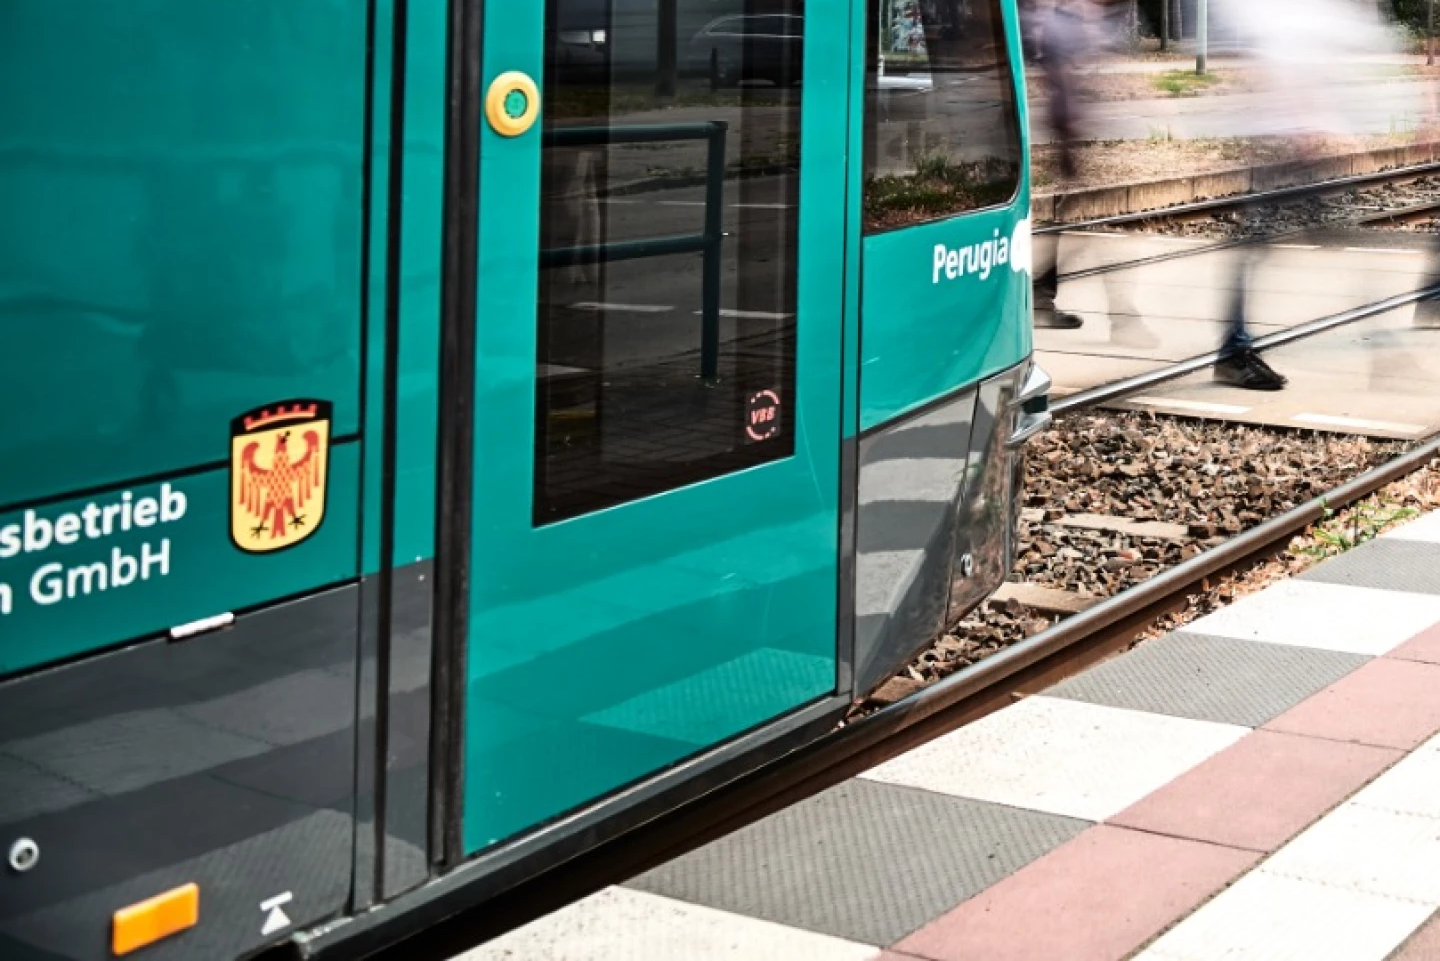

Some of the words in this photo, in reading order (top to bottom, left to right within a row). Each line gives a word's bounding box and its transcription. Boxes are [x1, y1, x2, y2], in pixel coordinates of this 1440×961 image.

[932, 228, 1008, 283] Perugia
[0, 482, 187, 558] sbetrieb
[30, 538, 170, 605] GmbH
